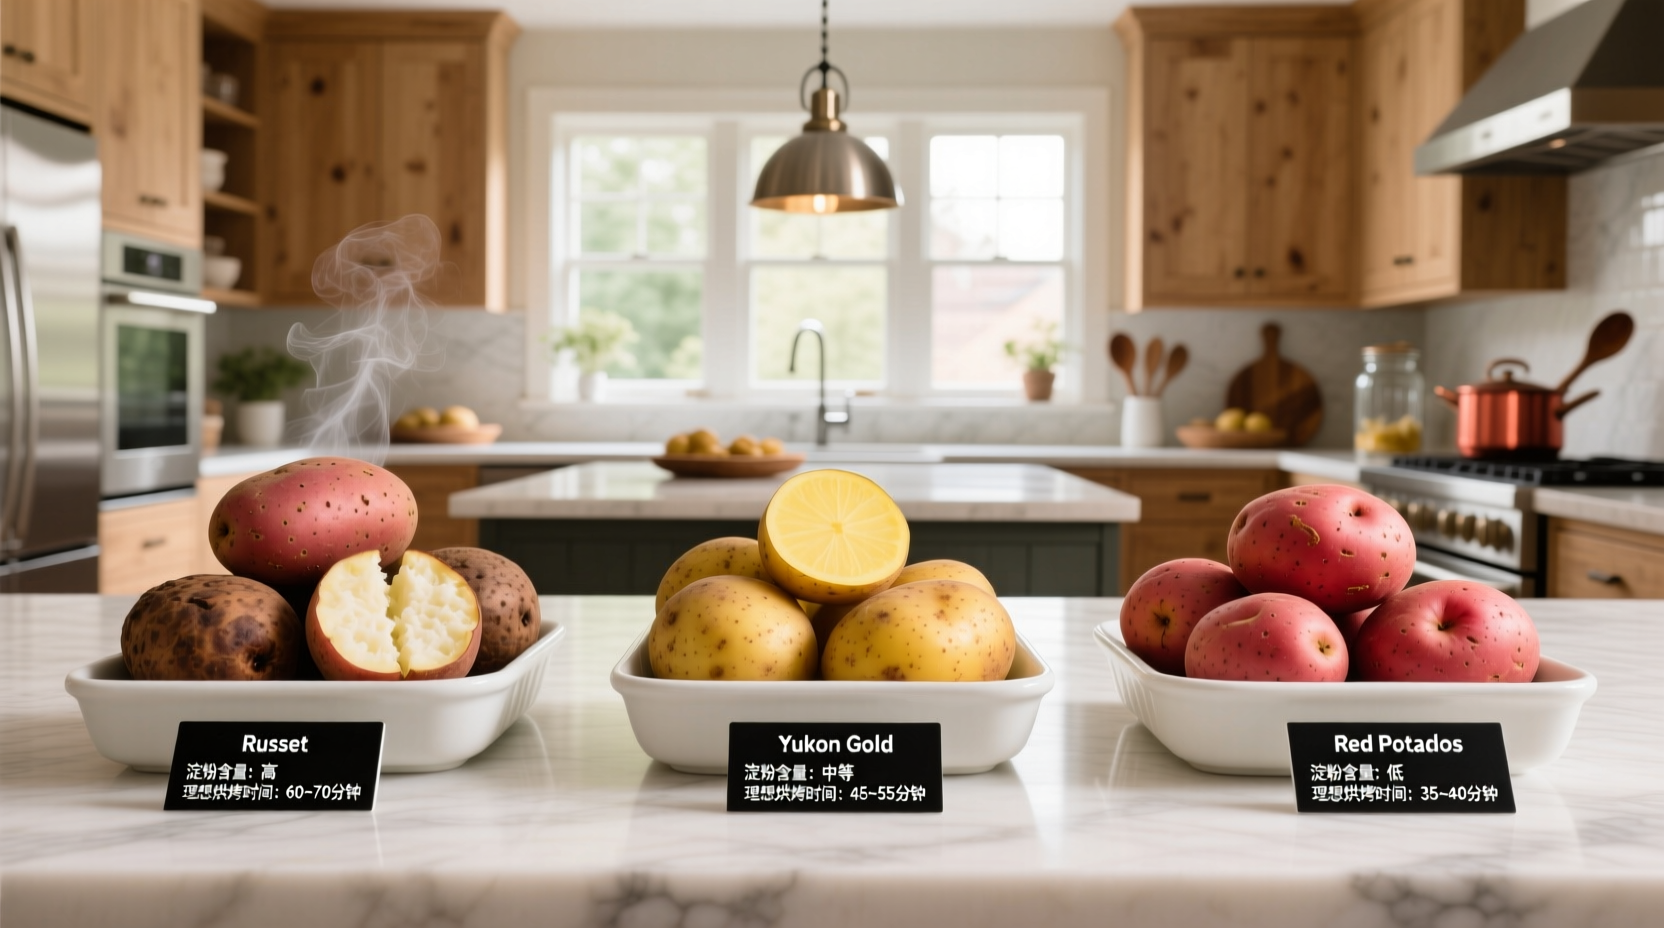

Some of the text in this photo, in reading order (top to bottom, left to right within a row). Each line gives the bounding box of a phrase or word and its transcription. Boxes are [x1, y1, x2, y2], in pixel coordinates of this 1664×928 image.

[243, 735, 309, 753] Russet
[779, 735, 894, 753] Yukon Gold
[1335, 734, 1464, 753] Red Potados
